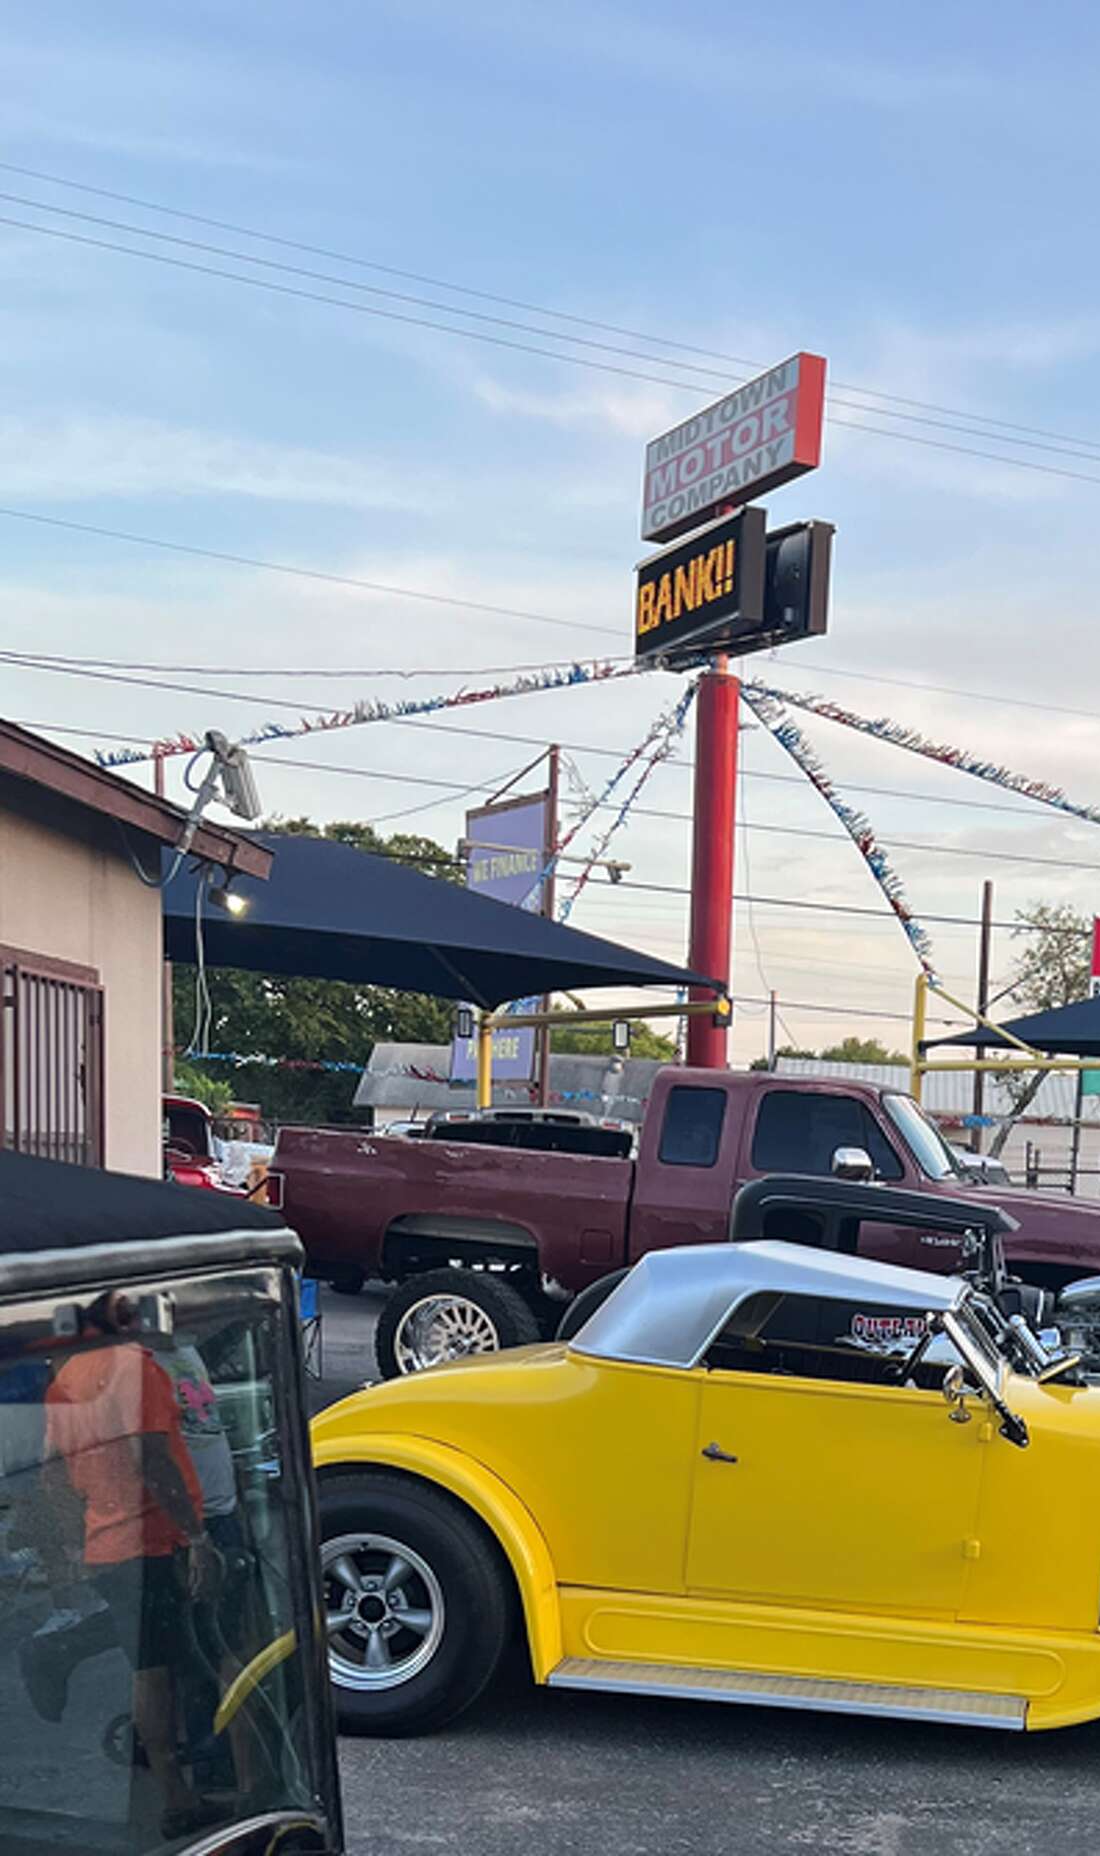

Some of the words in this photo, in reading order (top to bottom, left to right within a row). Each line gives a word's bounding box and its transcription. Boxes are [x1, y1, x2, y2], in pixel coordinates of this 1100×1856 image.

[650, 399, 790, 500] MOTOR
[655, 367, 788, 463] MIDTOWN
[651, 439, 785, 529] COMPANY
[637, 538, 735, 635] BANK!!
